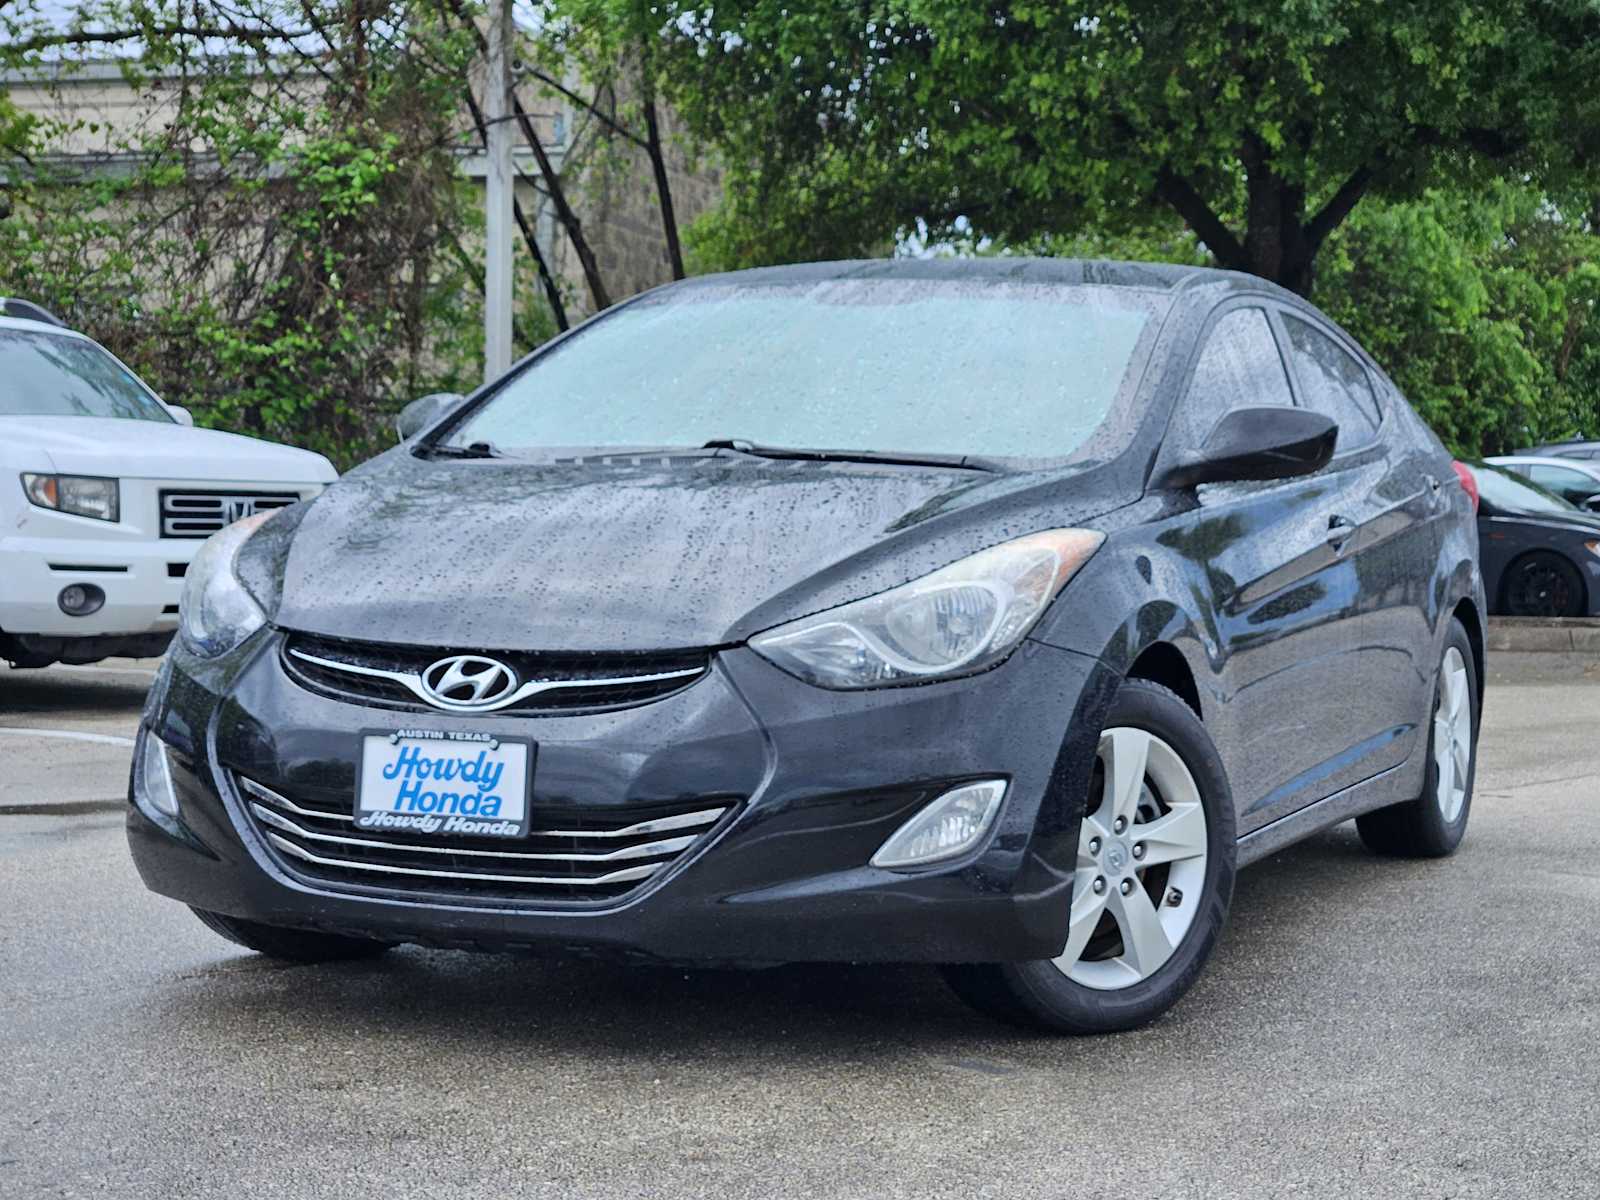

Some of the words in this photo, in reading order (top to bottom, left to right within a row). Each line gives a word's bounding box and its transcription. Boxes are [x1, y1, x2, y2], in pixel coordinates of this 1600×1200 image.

[397, 729, 444, 740] AUSTIN
[448, 731, 491, 742] TEXAS
[383, 745, 504, 792] Howdy
[394, 780, 503, 817] Honda
[360, 811, 443, 833] Howdy
[443, 816, 520, 836] Honda
